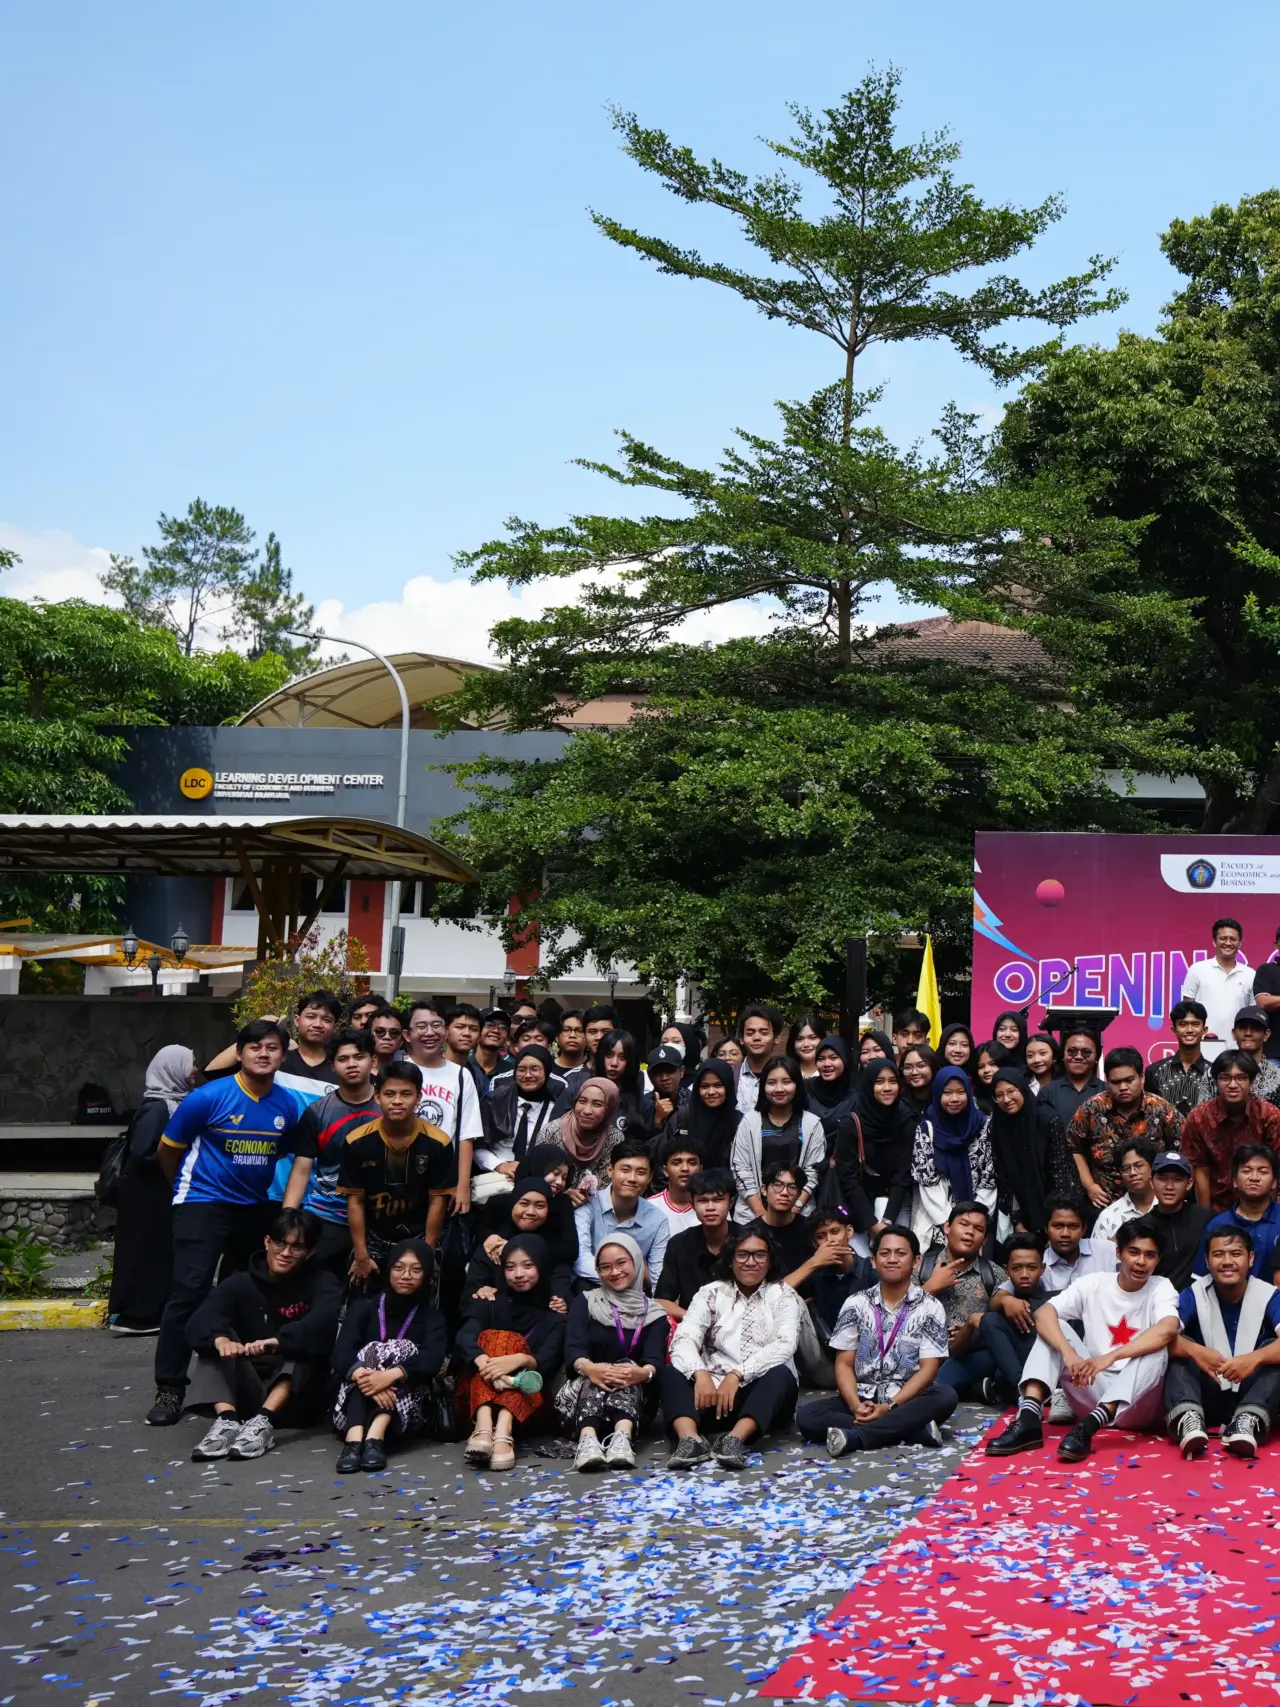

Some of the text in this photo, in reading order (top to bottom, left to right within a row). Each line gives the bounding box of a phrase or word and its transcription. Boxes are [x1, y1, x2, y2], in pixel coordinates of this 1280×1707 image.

[184, 778, 206, 788] LDC
[215, 772, 384, 785] LEARNING DEVELOPMENT CENTER
[289, 784, 303, 792] AND
[214, 790, 290, 799] UNIVERSITAS BRAWIJAYA
[993, 949, 1249, 1019] OPENIN
